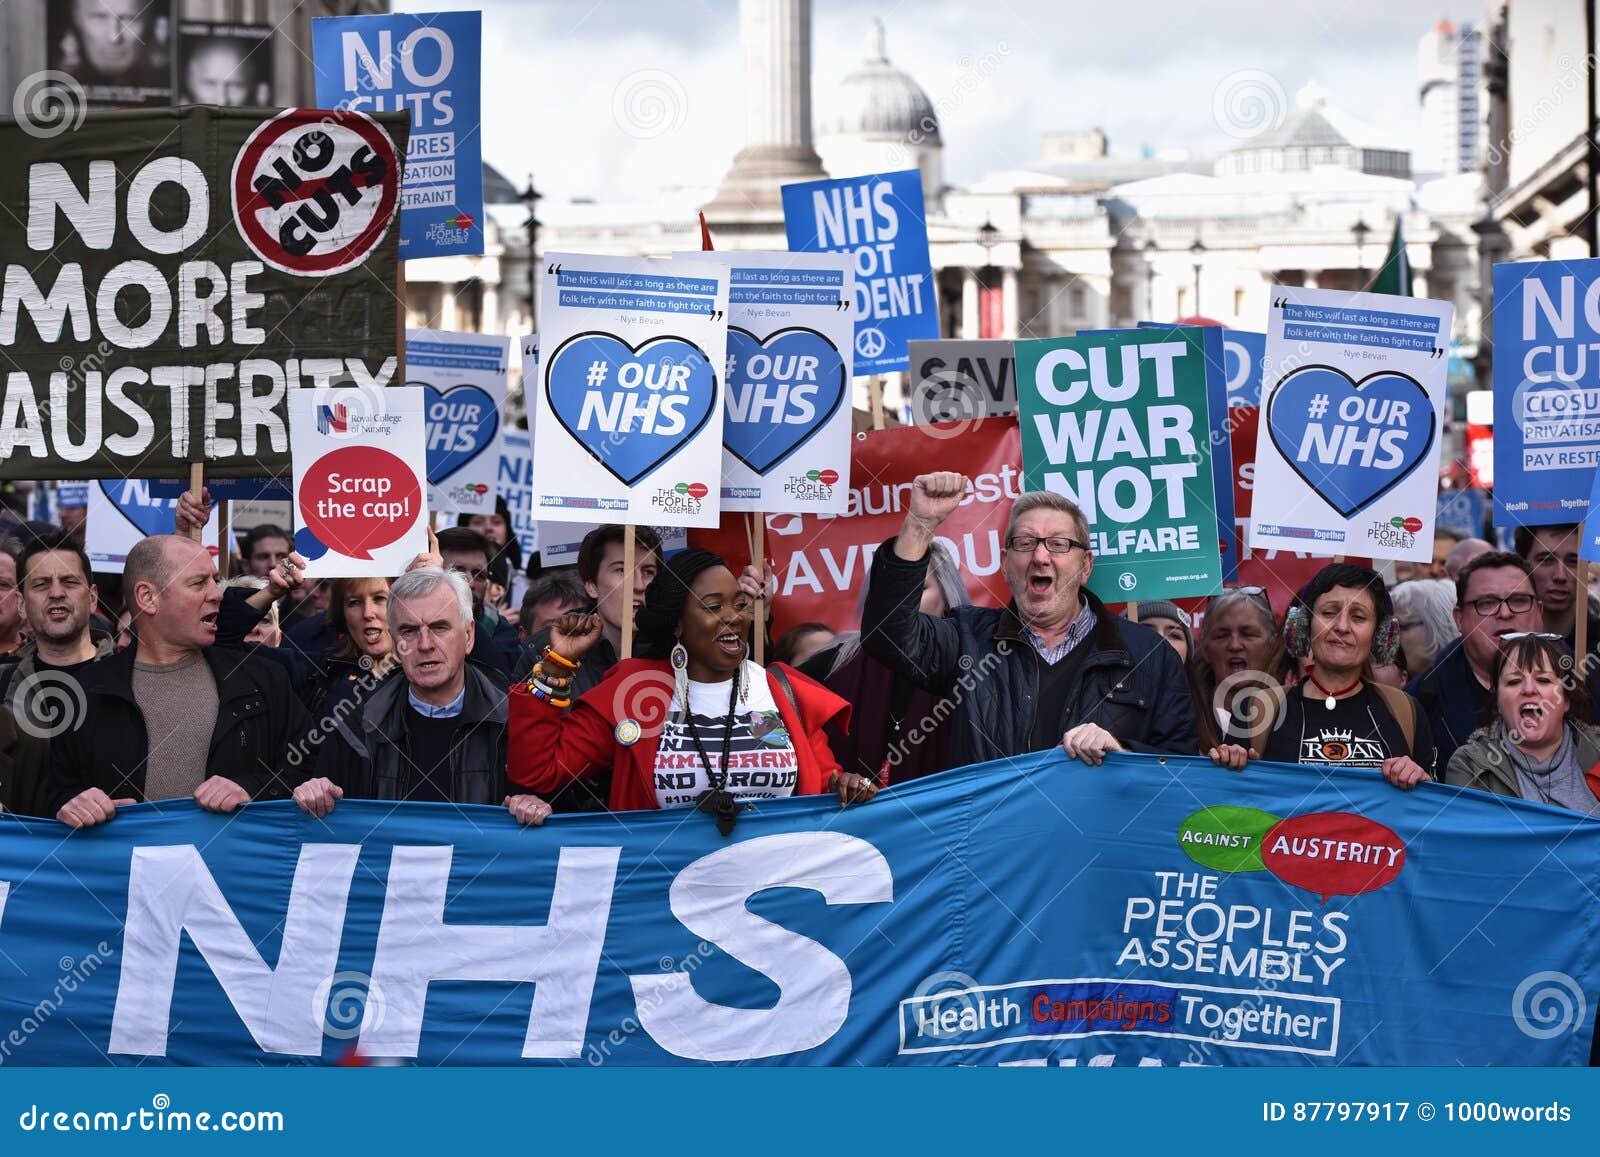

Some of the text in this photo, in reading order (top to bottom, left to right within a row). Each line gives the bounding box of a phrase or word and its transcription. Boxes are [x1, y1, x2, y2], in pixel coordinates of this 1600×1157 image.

[342, 27, 454, 91] NO
[408, 137, 449, 154] URES
[254, 131, 335, 212] NO
[404, 165, 453, 180] SATION
[27, 157, 210, 254] NO
[279, 145, 388, 257] CUTS
[401, 191, 453, 206] STRAINT
[812, 181, 899, 248] NHS
[842, 243, 895, 277] OT
[579, 275, 598, 285] NHS
[600, 276, 615, 286] will
[617, 277, 632, 287] last
[634, 280, 643, 288] as
[645, 279, 663, 291] long
[665, 281, 675, 289] as
[677, 281, 699, 291] there
[701, 284, 715, 292] are
[742, 273, 758, 281] last
[770, 273, 789, 283] long
[802, 274, 824, 282] there
[0, 259, 266, 349] MORE
[562, 294, 578, 304] folk
[580, 295, 596, 304] left
[598, 296, 617, 305] with
[619, 297, 634, 306] the
[636, 298, 655, 308] faith
[657, 300, 666, 309] to
[668, 300, 689, 312] fight
[690, 301, 703, 311] for
[745, 292, 759, 300] the
[762, 292, 781, 301] faith
[795, 293, 815, 303] fight
[816, 294, 829, 302] for
[855, 274, 923, 322] DENT
[1523, 275, 1600, 341] N
[747, 309, 791, 318] Nye Bevan
[1304, 310, 1322, 319] NHS
[1325, 312, 1340, 321] will
[1342, 312, 1357, 322] last
[1359, 315, 1368, 323] as
[1370, 315, 1388, 326] long
[1390, 318, 1400, 326] as
[1401, 319, 1421, 328] there
[1423, 322, 1437, 330] are
[1287, 327, 1302, 336] folk
[1305, 328, 1320, 338] left
[1322, 330, 1341, 339] with
[1343, 332, 1358, 341] the
[1360, 334, 1379, 343] faith
[1381, 336, 1390, 344] to
[1391, 336, 1411, 347] fight
[1412, 338, 1424, 347] for
[1344, 350, 1387, 361] Nye Bevan
[618, 362, 691, 391] OUR
[746, 354, 819, 381] OUR
[921, 356, 1018, 401] SAV
[1035, 341, 1187, 406] CUT
[429, 402, 481, 423] OUR
[577, 390, 690, 436] NHS
[1339, 395, 1411, 427] OUR
[1526, 392, 1600, 413] CLOSU
[351, 414, 402, 424] Royal College
[351, 424, 392, 435] of Nursing
[1033, 404, 1197, 465] WAR
[1296, 422, 1409, 470] NHS
[1525, 453, 1554, 467] PAY
[327, 473, 391, 498] Scrap
[790, 476, 807, 485] THE
[540, 495, 563, 506] Health
[598, 498, 629, 510] Together
[657, 488, 675, 497] THE
[730, 488, 761, 498] Together
[795, 494, 832, 502] ASSEMBLY
[1044, 462, 1198, 525] NOT
[317, 497, 409, 522] the cap!
[663, 506, 701, 515] ASSEMBLY
[1506, 502, 1528, 512] Health
[1257, 523, 1280, 535] Health
[1313, 528, 1345, 541] Together
[1373, 521, 1391, 531] THE
[1090, 525, 1200, 557] ELFARE
[1377, 539, 1414, 549] ASSEMBLY
[1181, 830, 1402, 868] AGAINST AUSTERITY
[1155, 871, 1218, 900] THE
[108, 829, 894, 1062] NHS
[1115, 937, 1347, 986] ASSEMBLY
[917, 992, 1328, 1040] Health Campaigns Together
